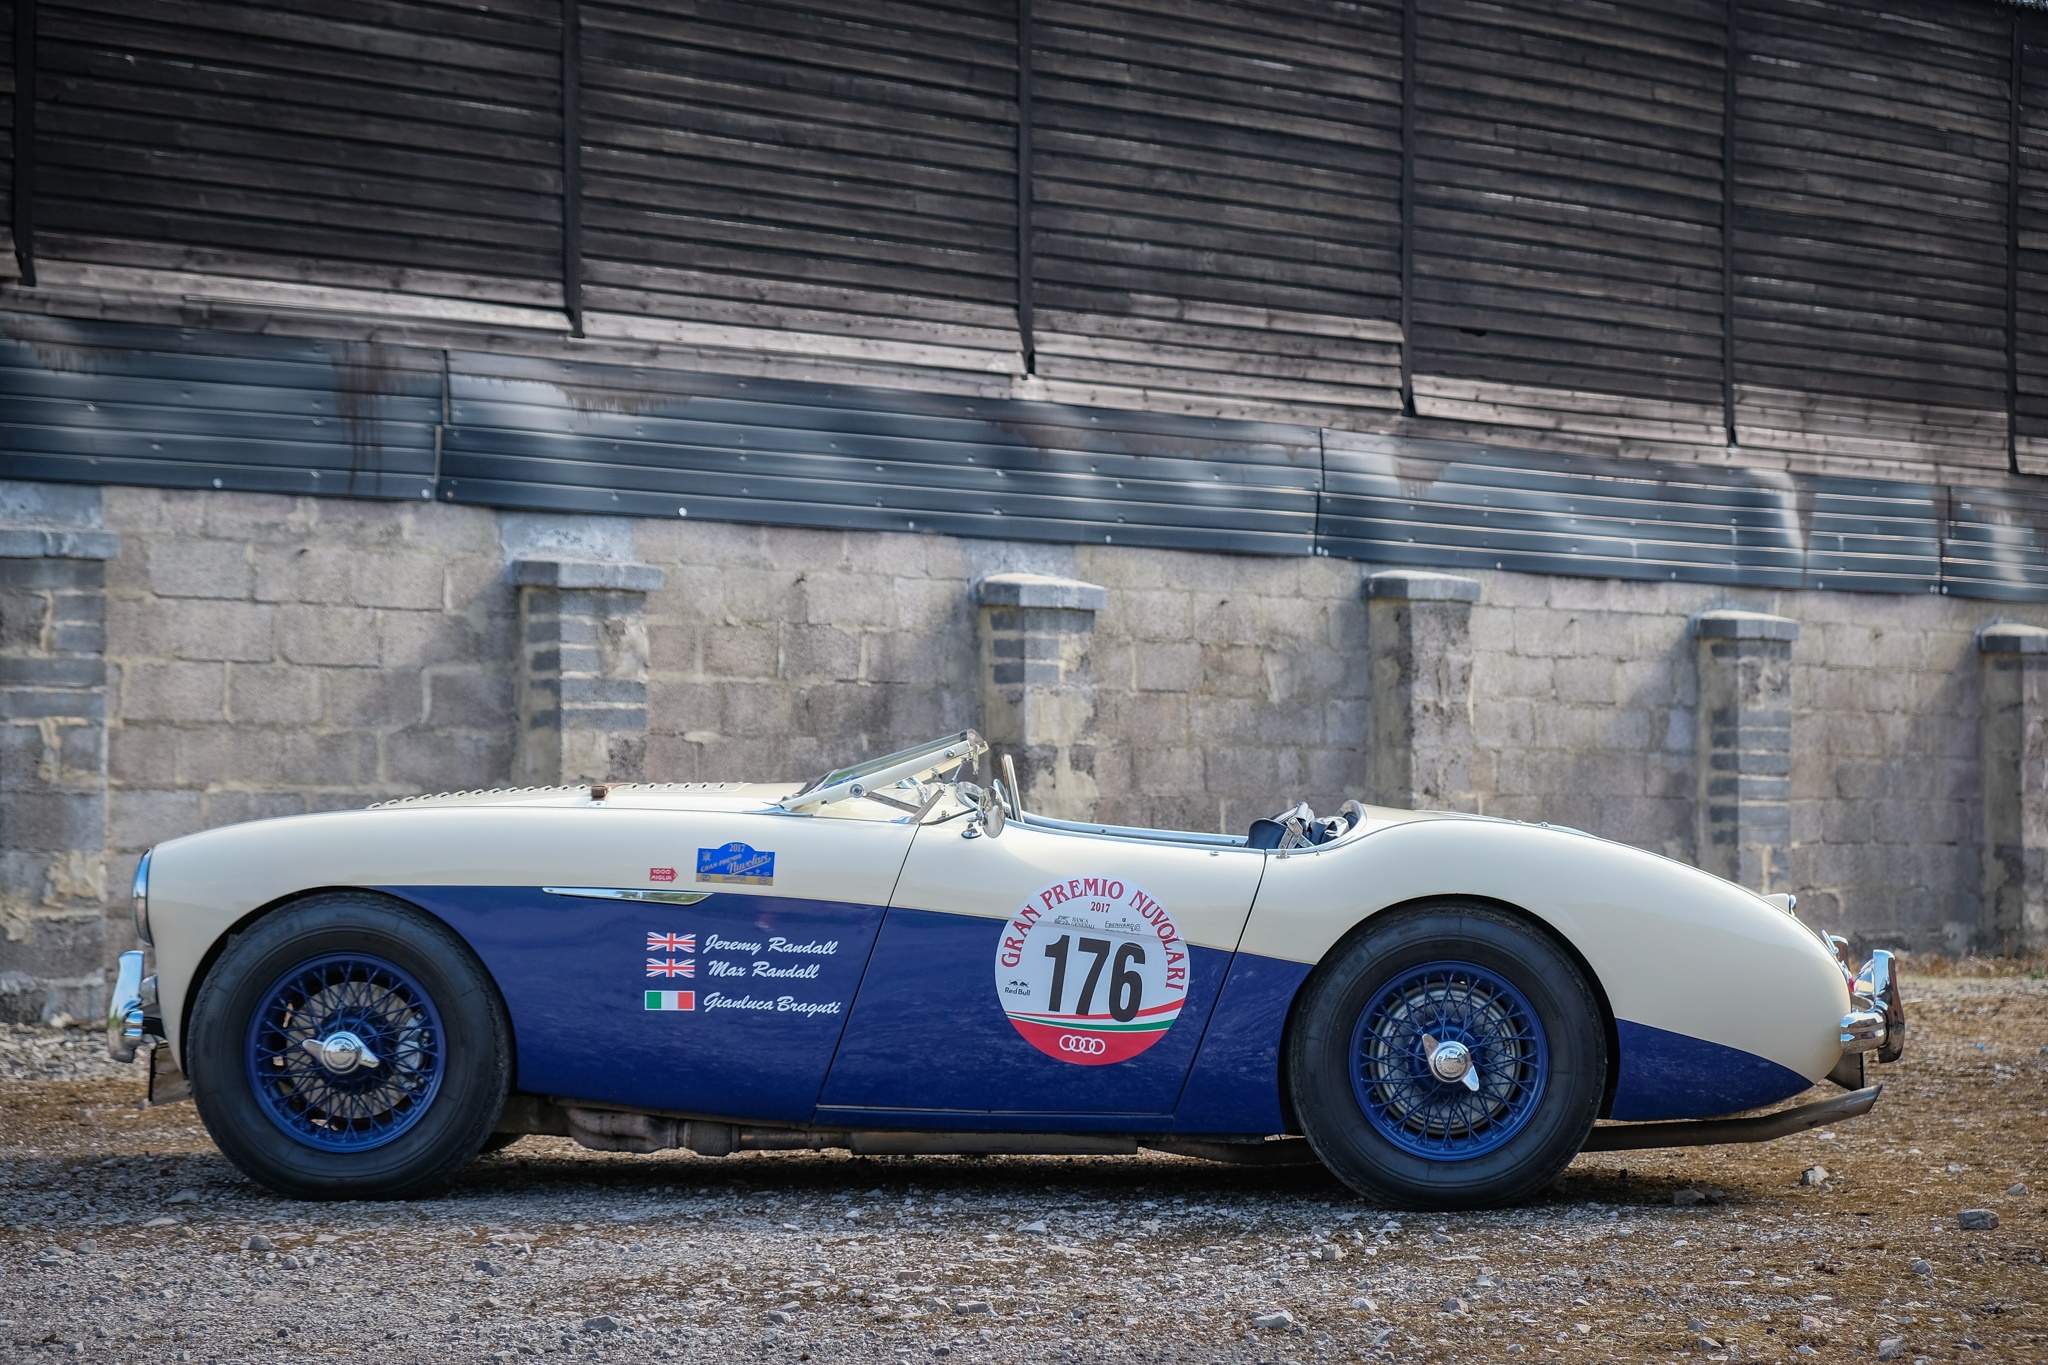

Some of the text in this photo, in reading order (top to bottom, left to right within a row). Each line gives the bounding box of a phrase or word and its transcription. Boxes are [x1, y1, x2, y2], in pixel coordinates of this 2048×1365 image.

[728, 843, 745, 852] 2017
[700, 853, 743, 872] GRAN PREMIO
[727, 852, 771, 874] Nuvolari
[1090, 901, 1111, 913] 2017
[1001, 878, 1186, 991] GRAN PREMIO NUVOLARI
[702, 934, 839, 956] Jeremy Randall
[707, 960, 821, 979] Max Randall
[1044, 934, 1146, 1023] 176
[1004, 986, 1031, 996] Red Bull
[703, 992, 842, 1018] Gianluca Braguti
